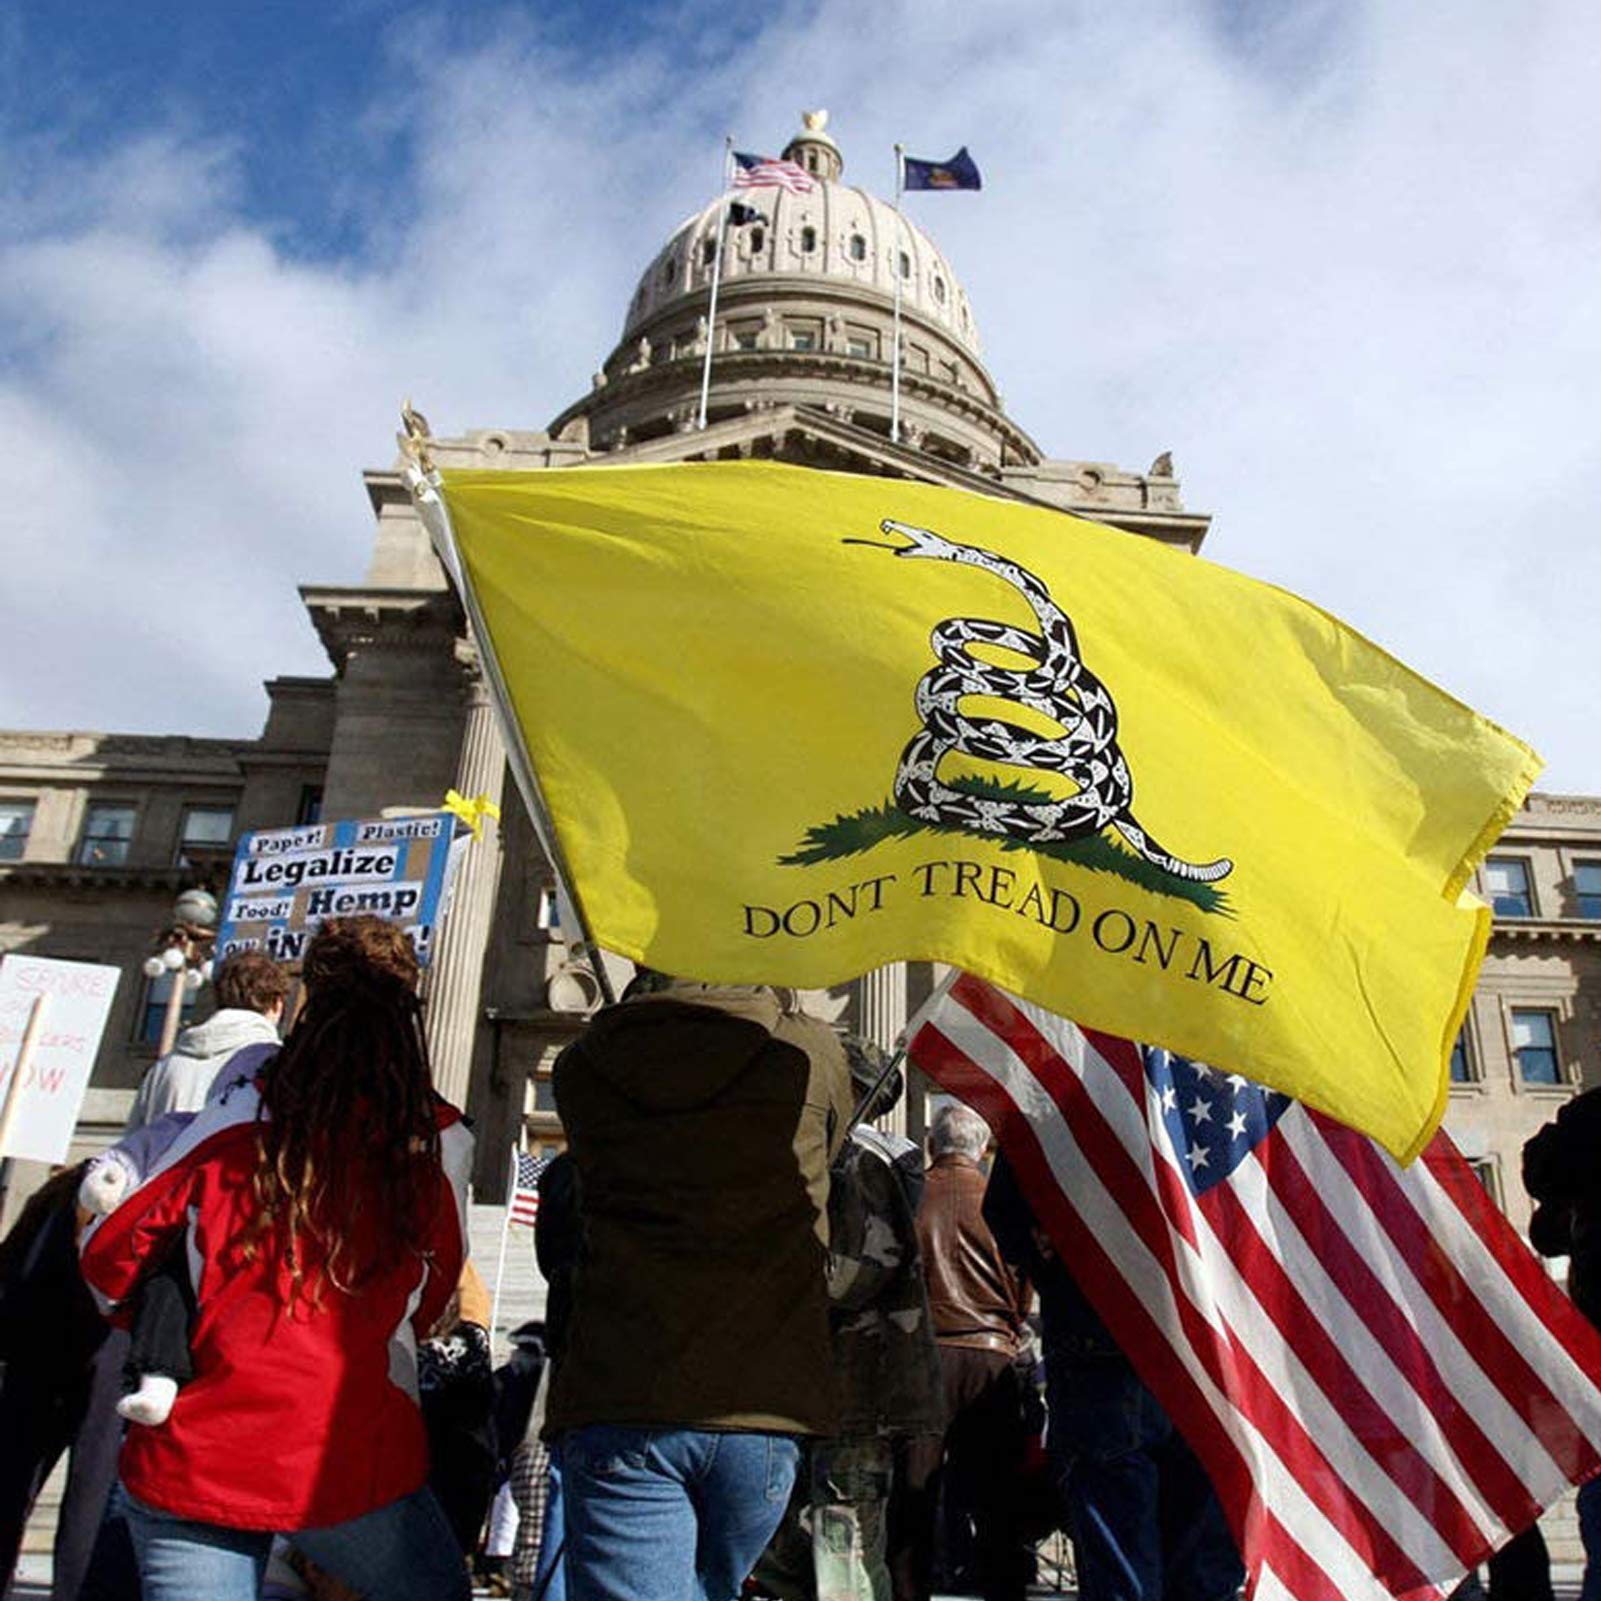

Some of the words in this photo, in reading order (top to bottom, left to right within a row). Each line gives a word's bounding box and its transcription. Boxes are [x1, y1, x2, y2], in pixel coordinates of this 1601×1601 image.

[256, 830, 321, 851] Paper!
[363, 820, 439, 840] Plastic!
[243, 849, 394, 886] Legalize
[307, 887, 417, 916] Hemp
[742, 874, 897, 938] DONT
[913, 861, 1082, 934] TREAD
[1092, 908, 1184, 971] ON
[1186, 938, 1275, 1006] ME
